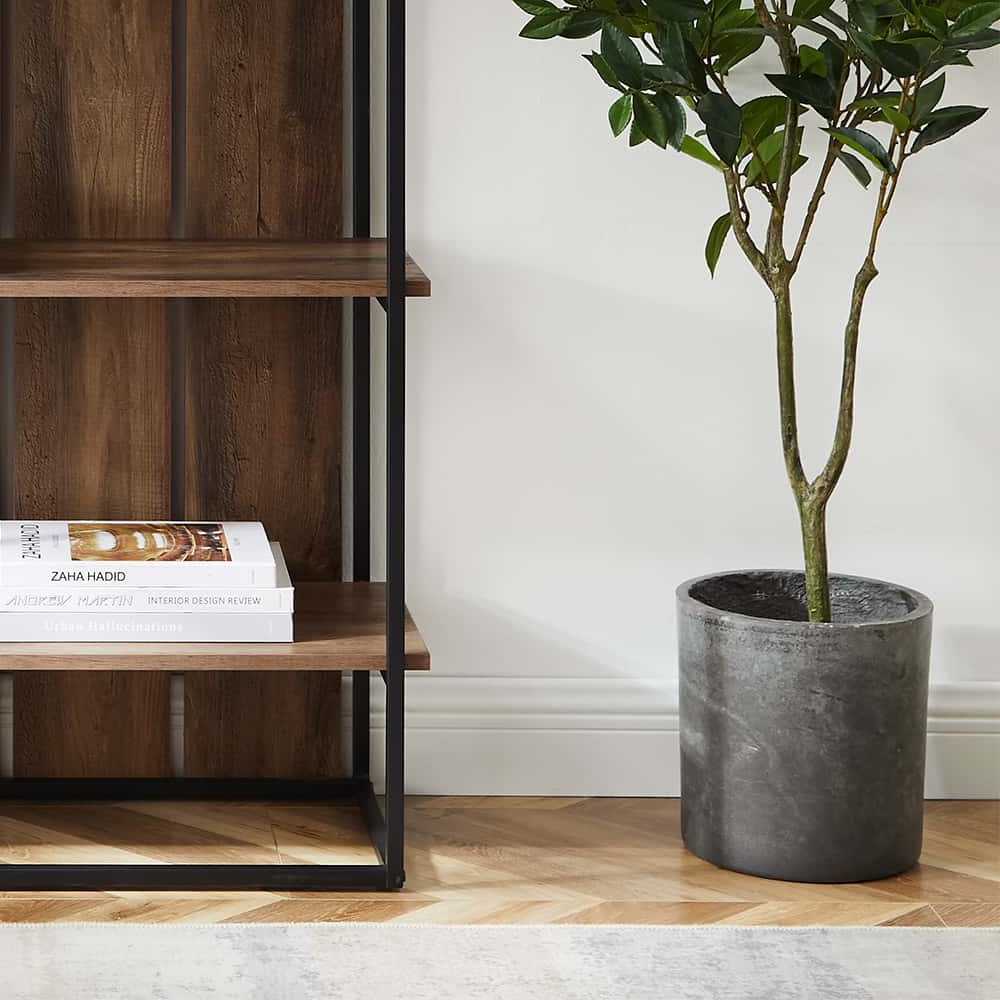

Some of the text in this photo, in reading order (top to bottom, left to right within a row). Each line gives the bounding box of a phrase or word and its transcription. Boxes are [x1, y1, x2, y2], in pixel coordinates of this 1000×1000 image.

[51, 571, 126, 582] ZAHA HADID
[147, 596, 262, 606] INTERIOR DESIGN REVIEW
